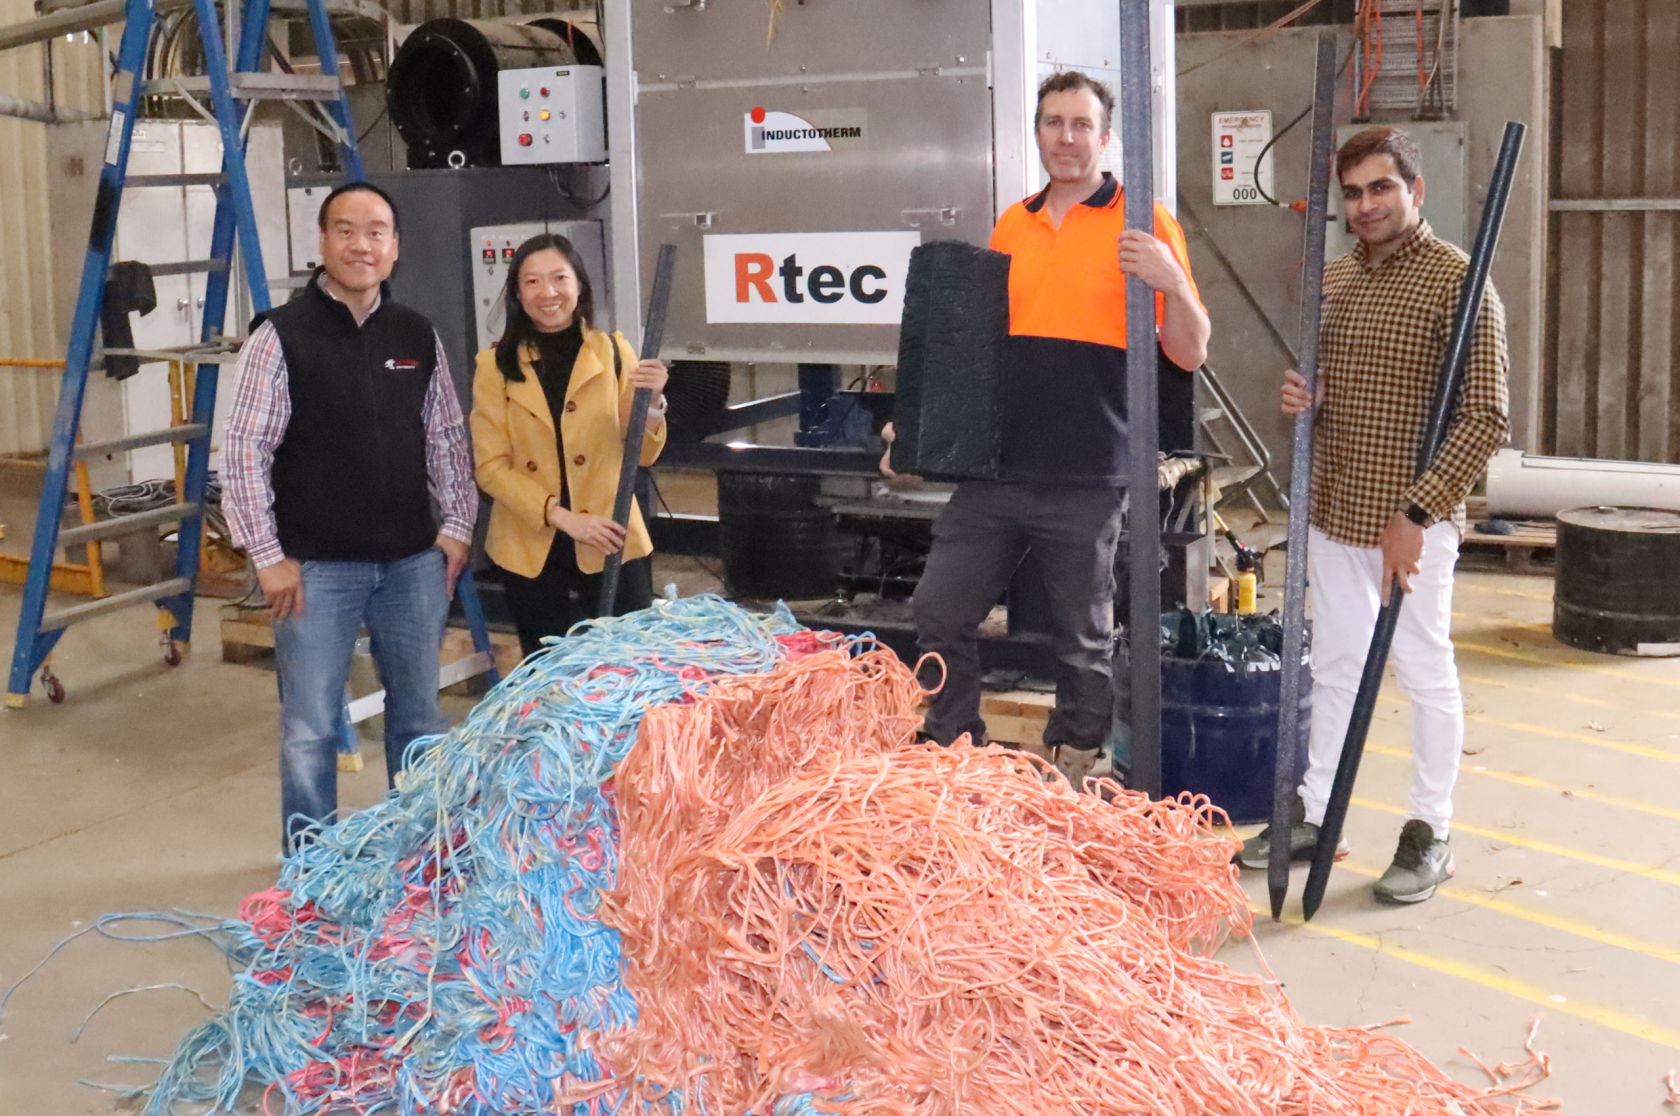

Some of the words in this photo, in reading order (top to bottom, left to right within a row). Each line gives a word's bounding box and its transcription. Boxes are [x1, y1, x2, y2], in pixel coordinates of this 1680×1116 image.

[762, 127, 861, 140] INDUCTOTHERM
[1233, 188, 1257, 200] 000
[735, 252, 888, 304] Rtec
